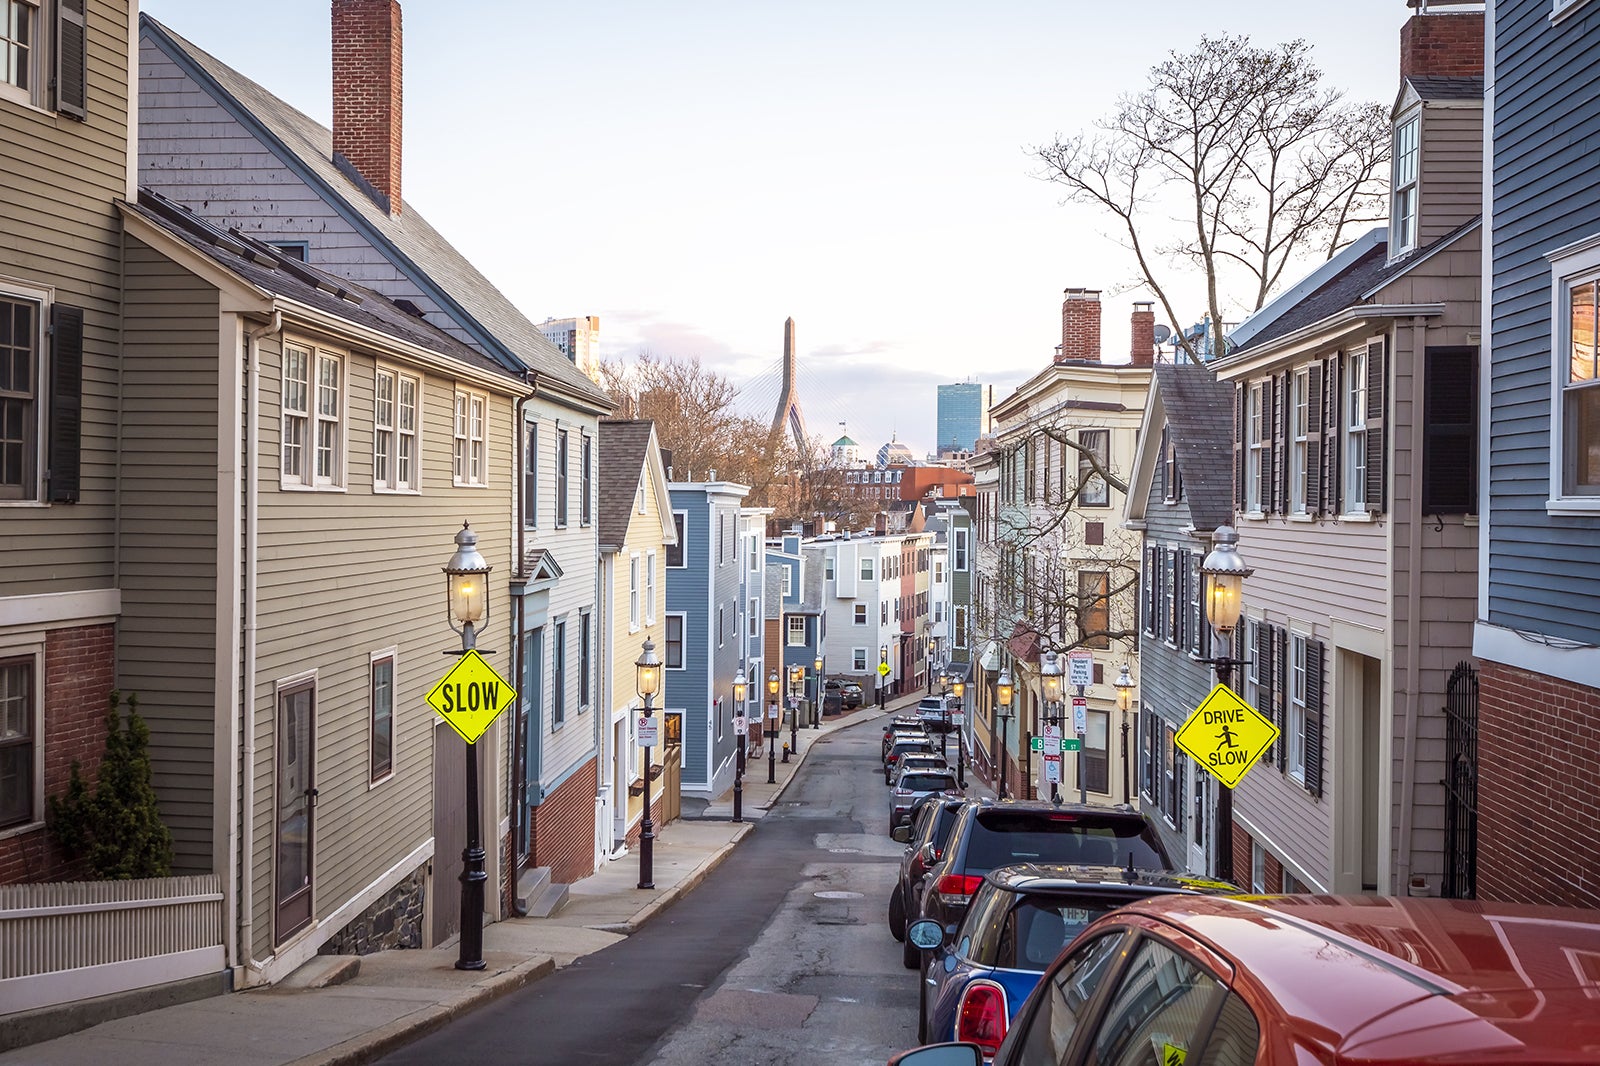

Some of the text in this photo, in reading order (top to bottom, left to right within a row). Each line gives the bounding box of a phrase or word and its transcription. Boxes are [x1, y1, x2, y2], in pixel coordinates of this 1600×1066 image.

[442, 681, 499, 713] SLOW
[1204, 709, 1245, 725] DRIVE
[1208, 750, 1248, 766] SLOW
